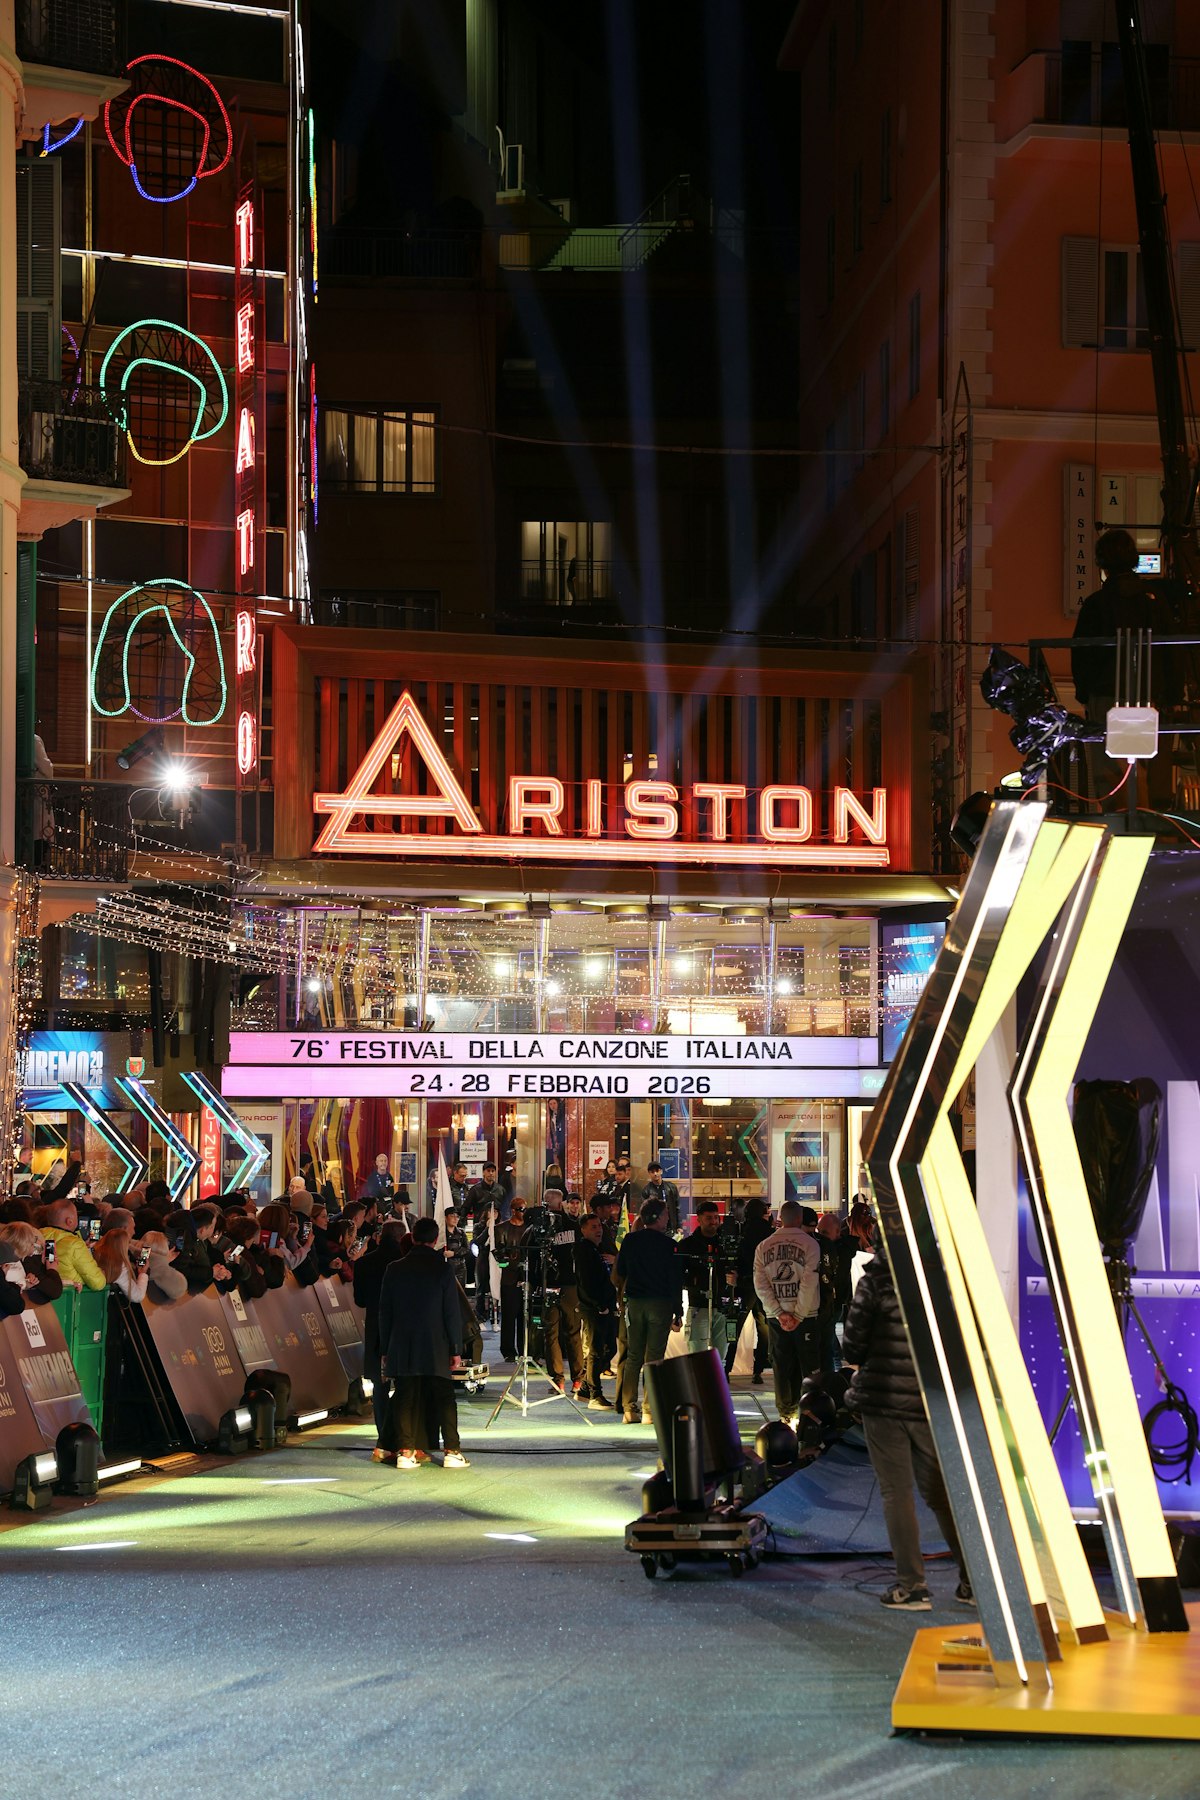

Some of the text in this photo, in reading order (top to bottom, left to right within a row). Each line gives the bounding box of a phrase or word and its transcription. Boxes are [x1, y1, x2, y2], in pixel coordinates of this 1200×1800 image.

[236, 200, 255, 774] TEATRO
[1109, 480, 1118, 506] LA
[1076, 471, 1086, 606] LA STAMPA
[313, 689, 888, 858] ARISTON
[340, 1041, 453, 1059] FESTIVAL
[469, 1040, 544, 1059] DELLA
[559, 1041, 669, 1059] CANZONE
[686, 1040, 793, 1060] ITALIANA
[508, 1075, 629, 1094] FEBBRAIO
[647, 1076, 711, 1094] 2026
[204, 1108, 217, 1187] CINEMA
[763, 1244, 806, 1267] LOS ANGELES
[25, 1320, 40, 1337] Rai
[202, 1326, 225, 1353] 100
[213, 1354, 231, 1369] ANNI
